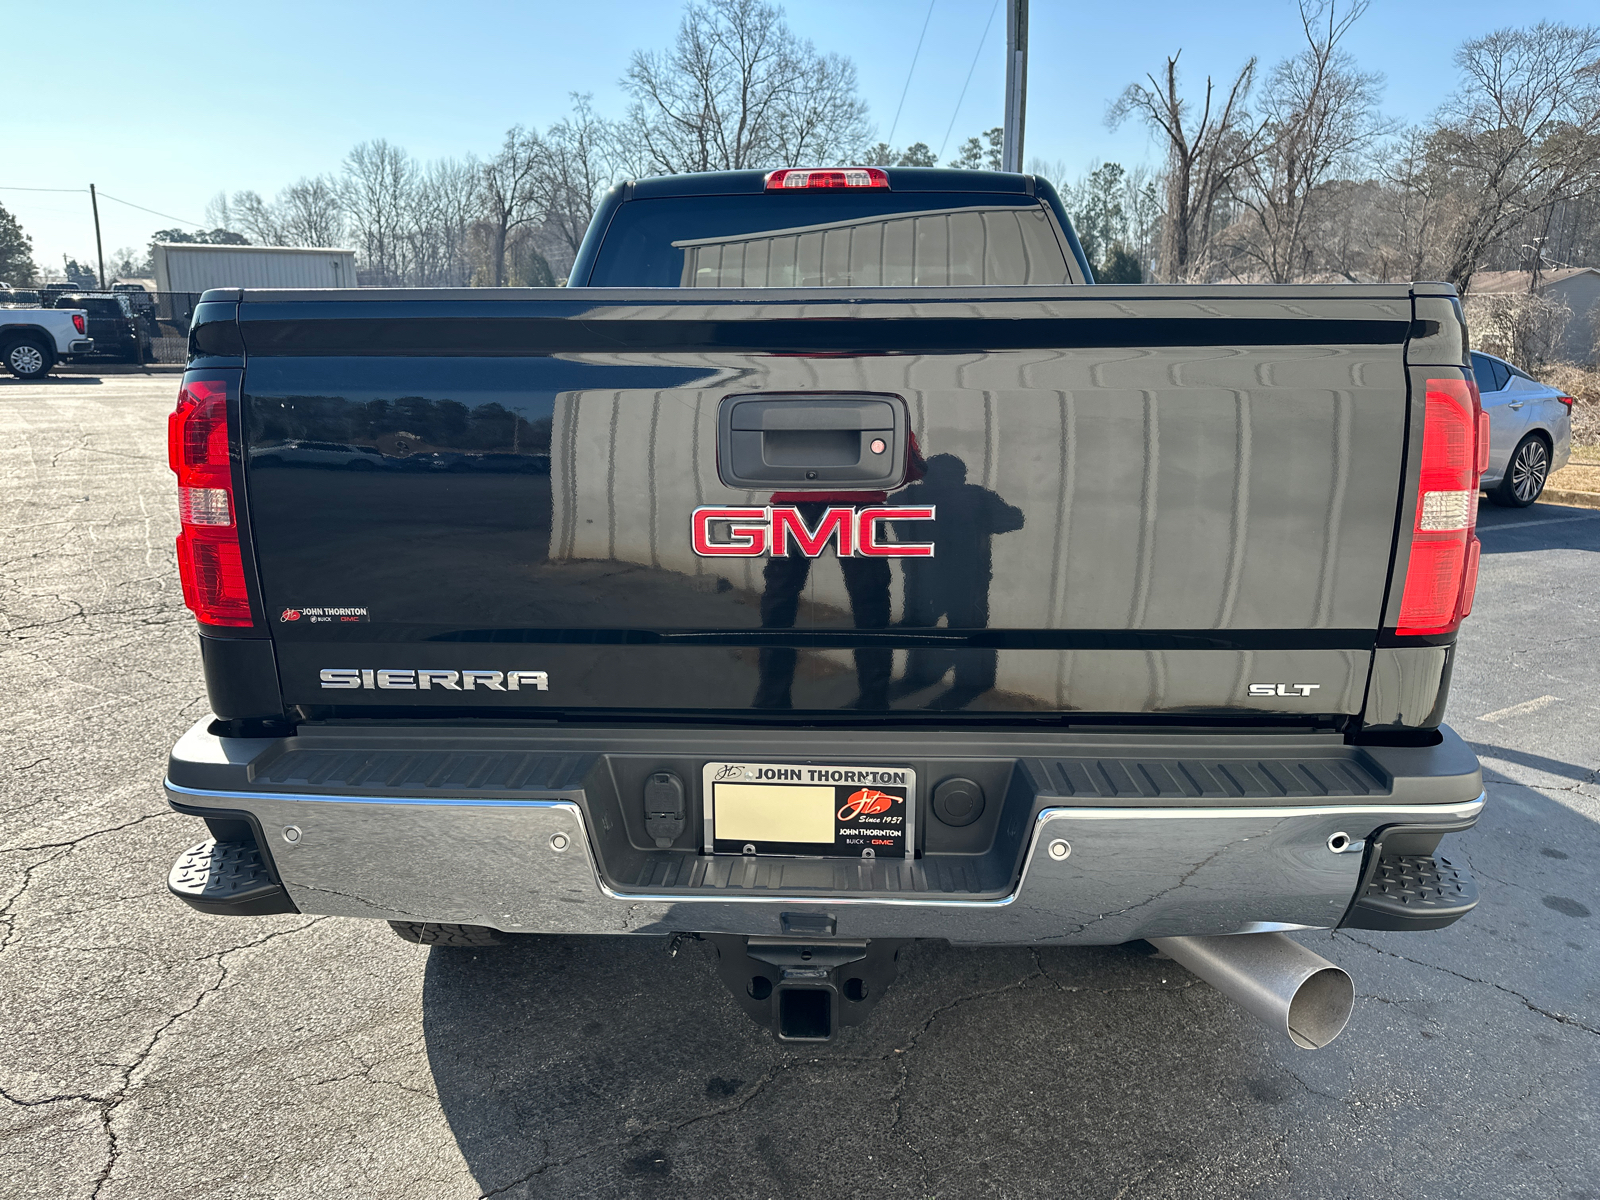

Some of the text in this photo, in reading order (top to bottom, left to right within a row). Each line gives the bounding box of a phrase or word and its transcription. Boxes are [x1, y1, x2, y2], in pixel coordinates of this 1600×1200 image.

[692, 505, 936, 558] GMC
[320, 669, 549, 691] SIERRA
[1248, 683, 1320, 697] SLT
[755, 768, 801, 781] JOHN
[808, 769, 906, 784] THORNTON
[860, 829, 902, 837] THORNTON
